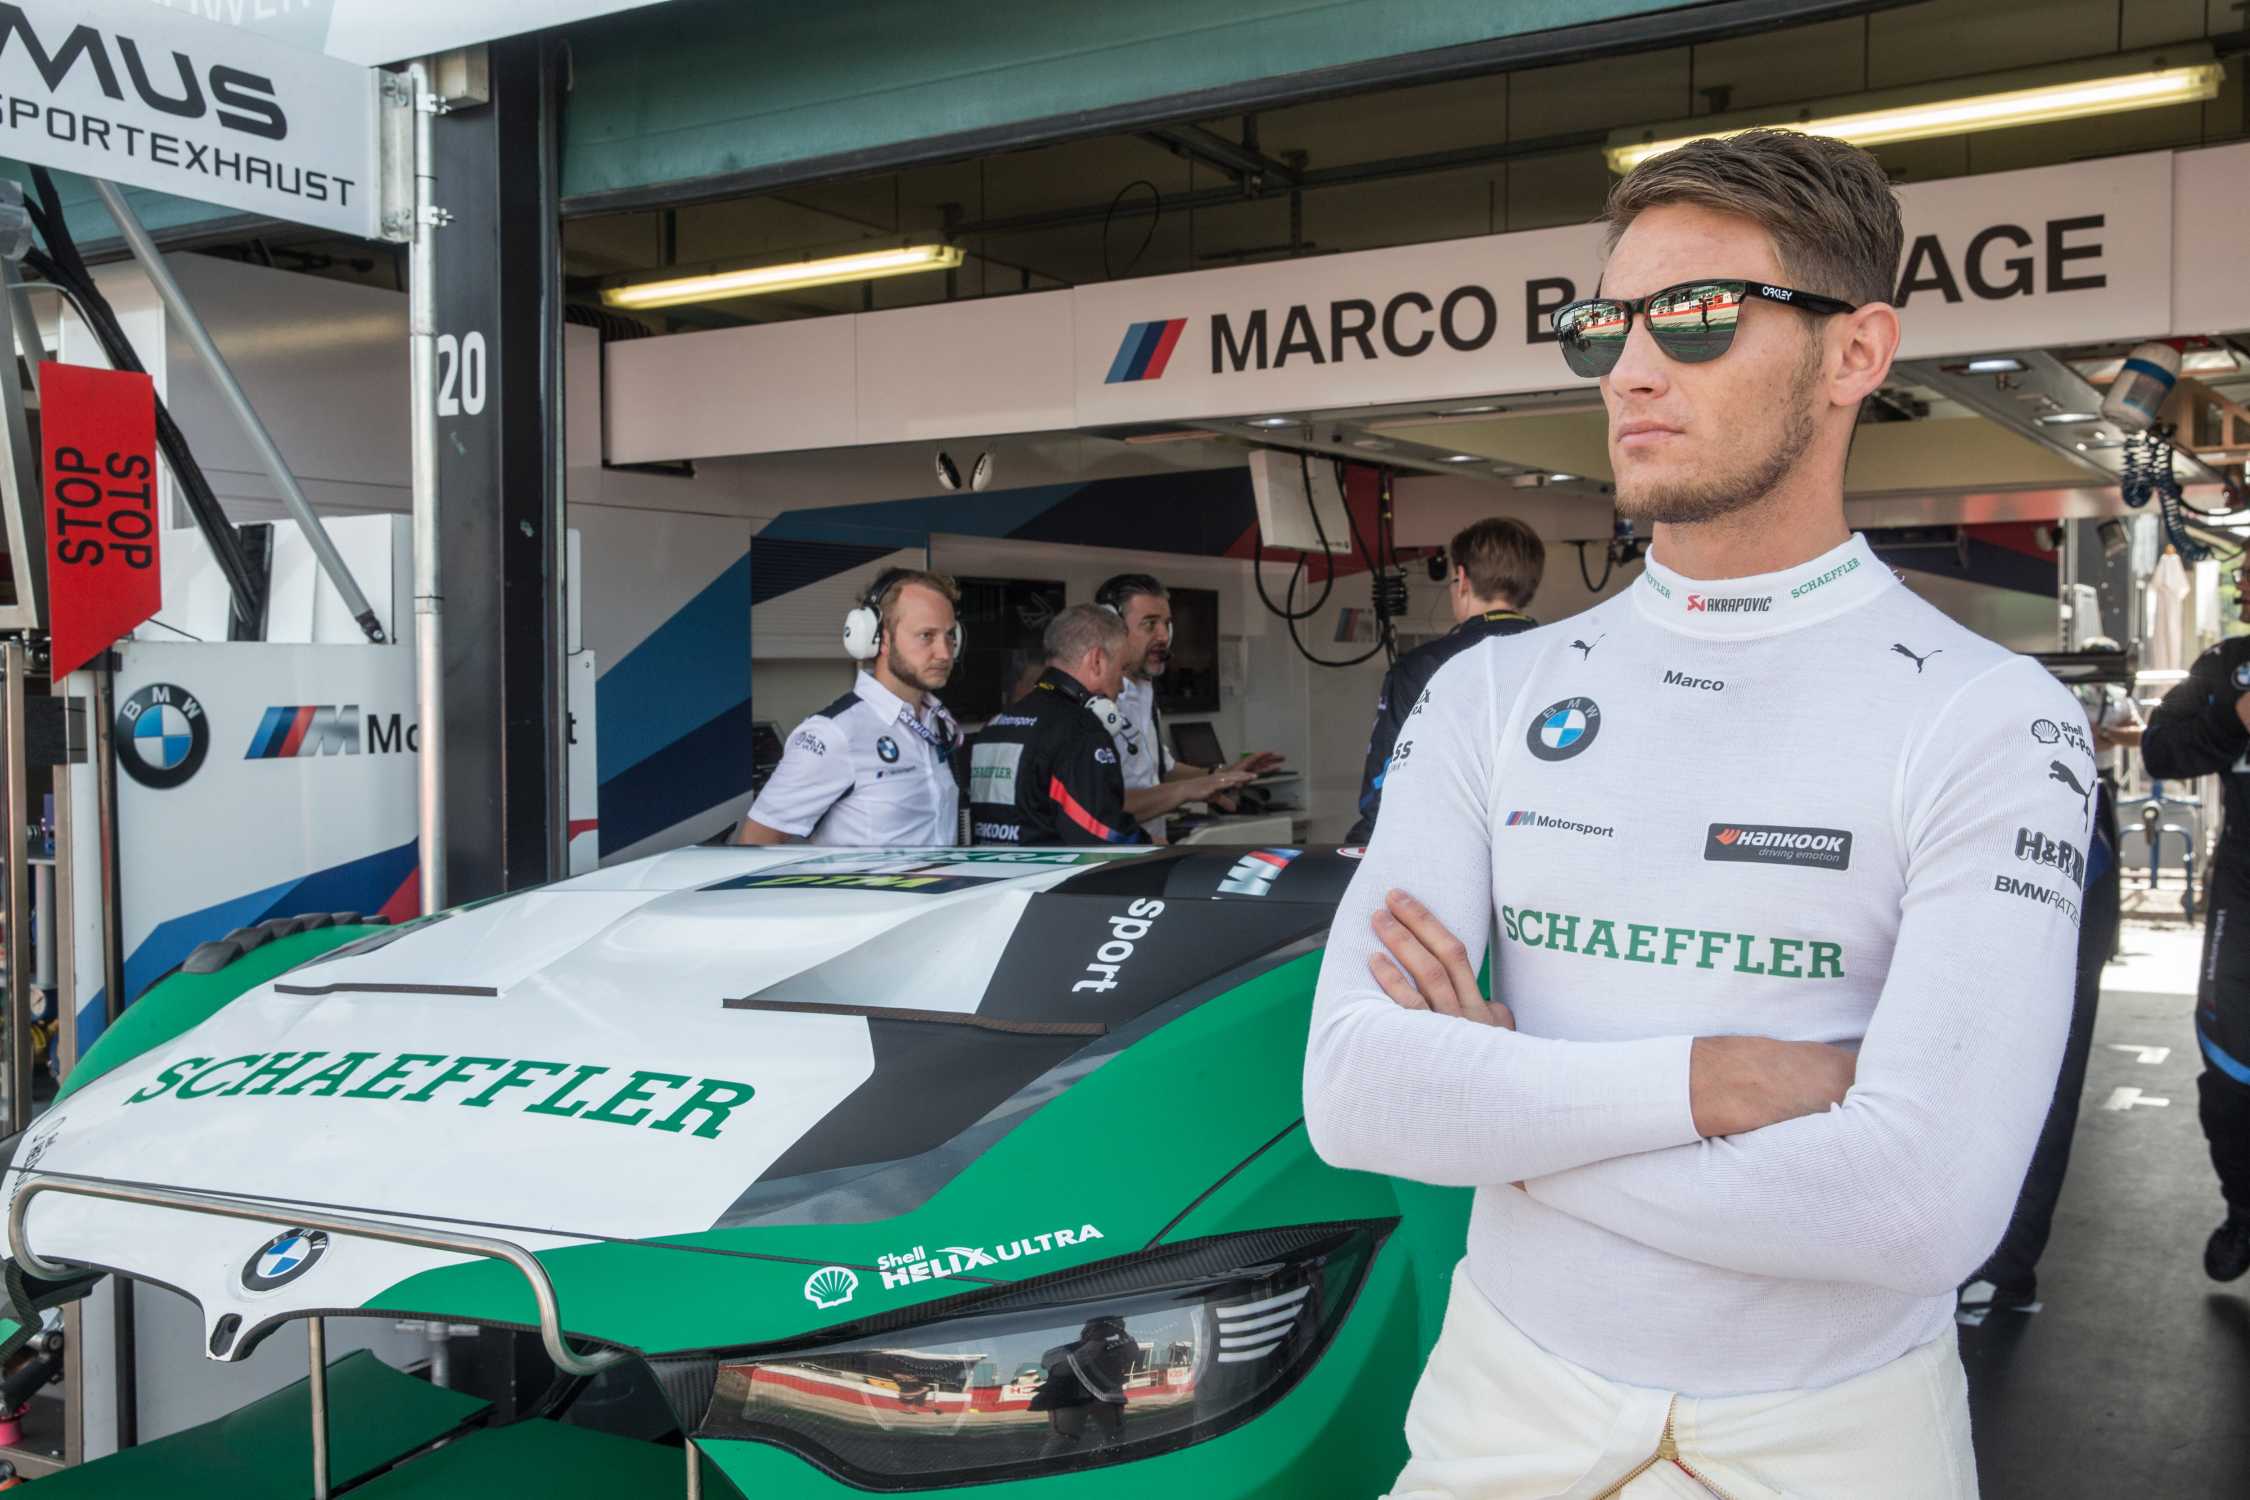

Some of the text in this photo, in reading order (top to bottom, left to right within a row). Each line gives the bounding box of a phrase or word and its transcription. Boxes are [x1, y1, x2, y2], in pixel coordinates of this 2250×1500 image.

[0, 94, 356, 206] PORTEXHAUST
[1211, 285, 1497, 374] MARCO
[437, 331, 487, 416] 20
[55, 447, 104, 567] STOP
[106, 452, 152, 570] STOP
[1791, 557, 1862, 599] SCHAEFFLER
[1663, 670, 1725, 691] Marco
[122, 686, 202, 721] BMW
[1542, 698, 1599, 719] BMW
[2060, 721, 2084, 737] Shell
[976, 822, 1020, 841] KOOK
[1536, 815, 1615, 838] Motorsport
[1758, 847, 1840, 863] driving emotion
[1502, 905, 1846, 980] SCHAEFFLER
[128, 1051, 756, 1140] SCHAEFFLER
[877, 1246, 926, 1271] Shell
